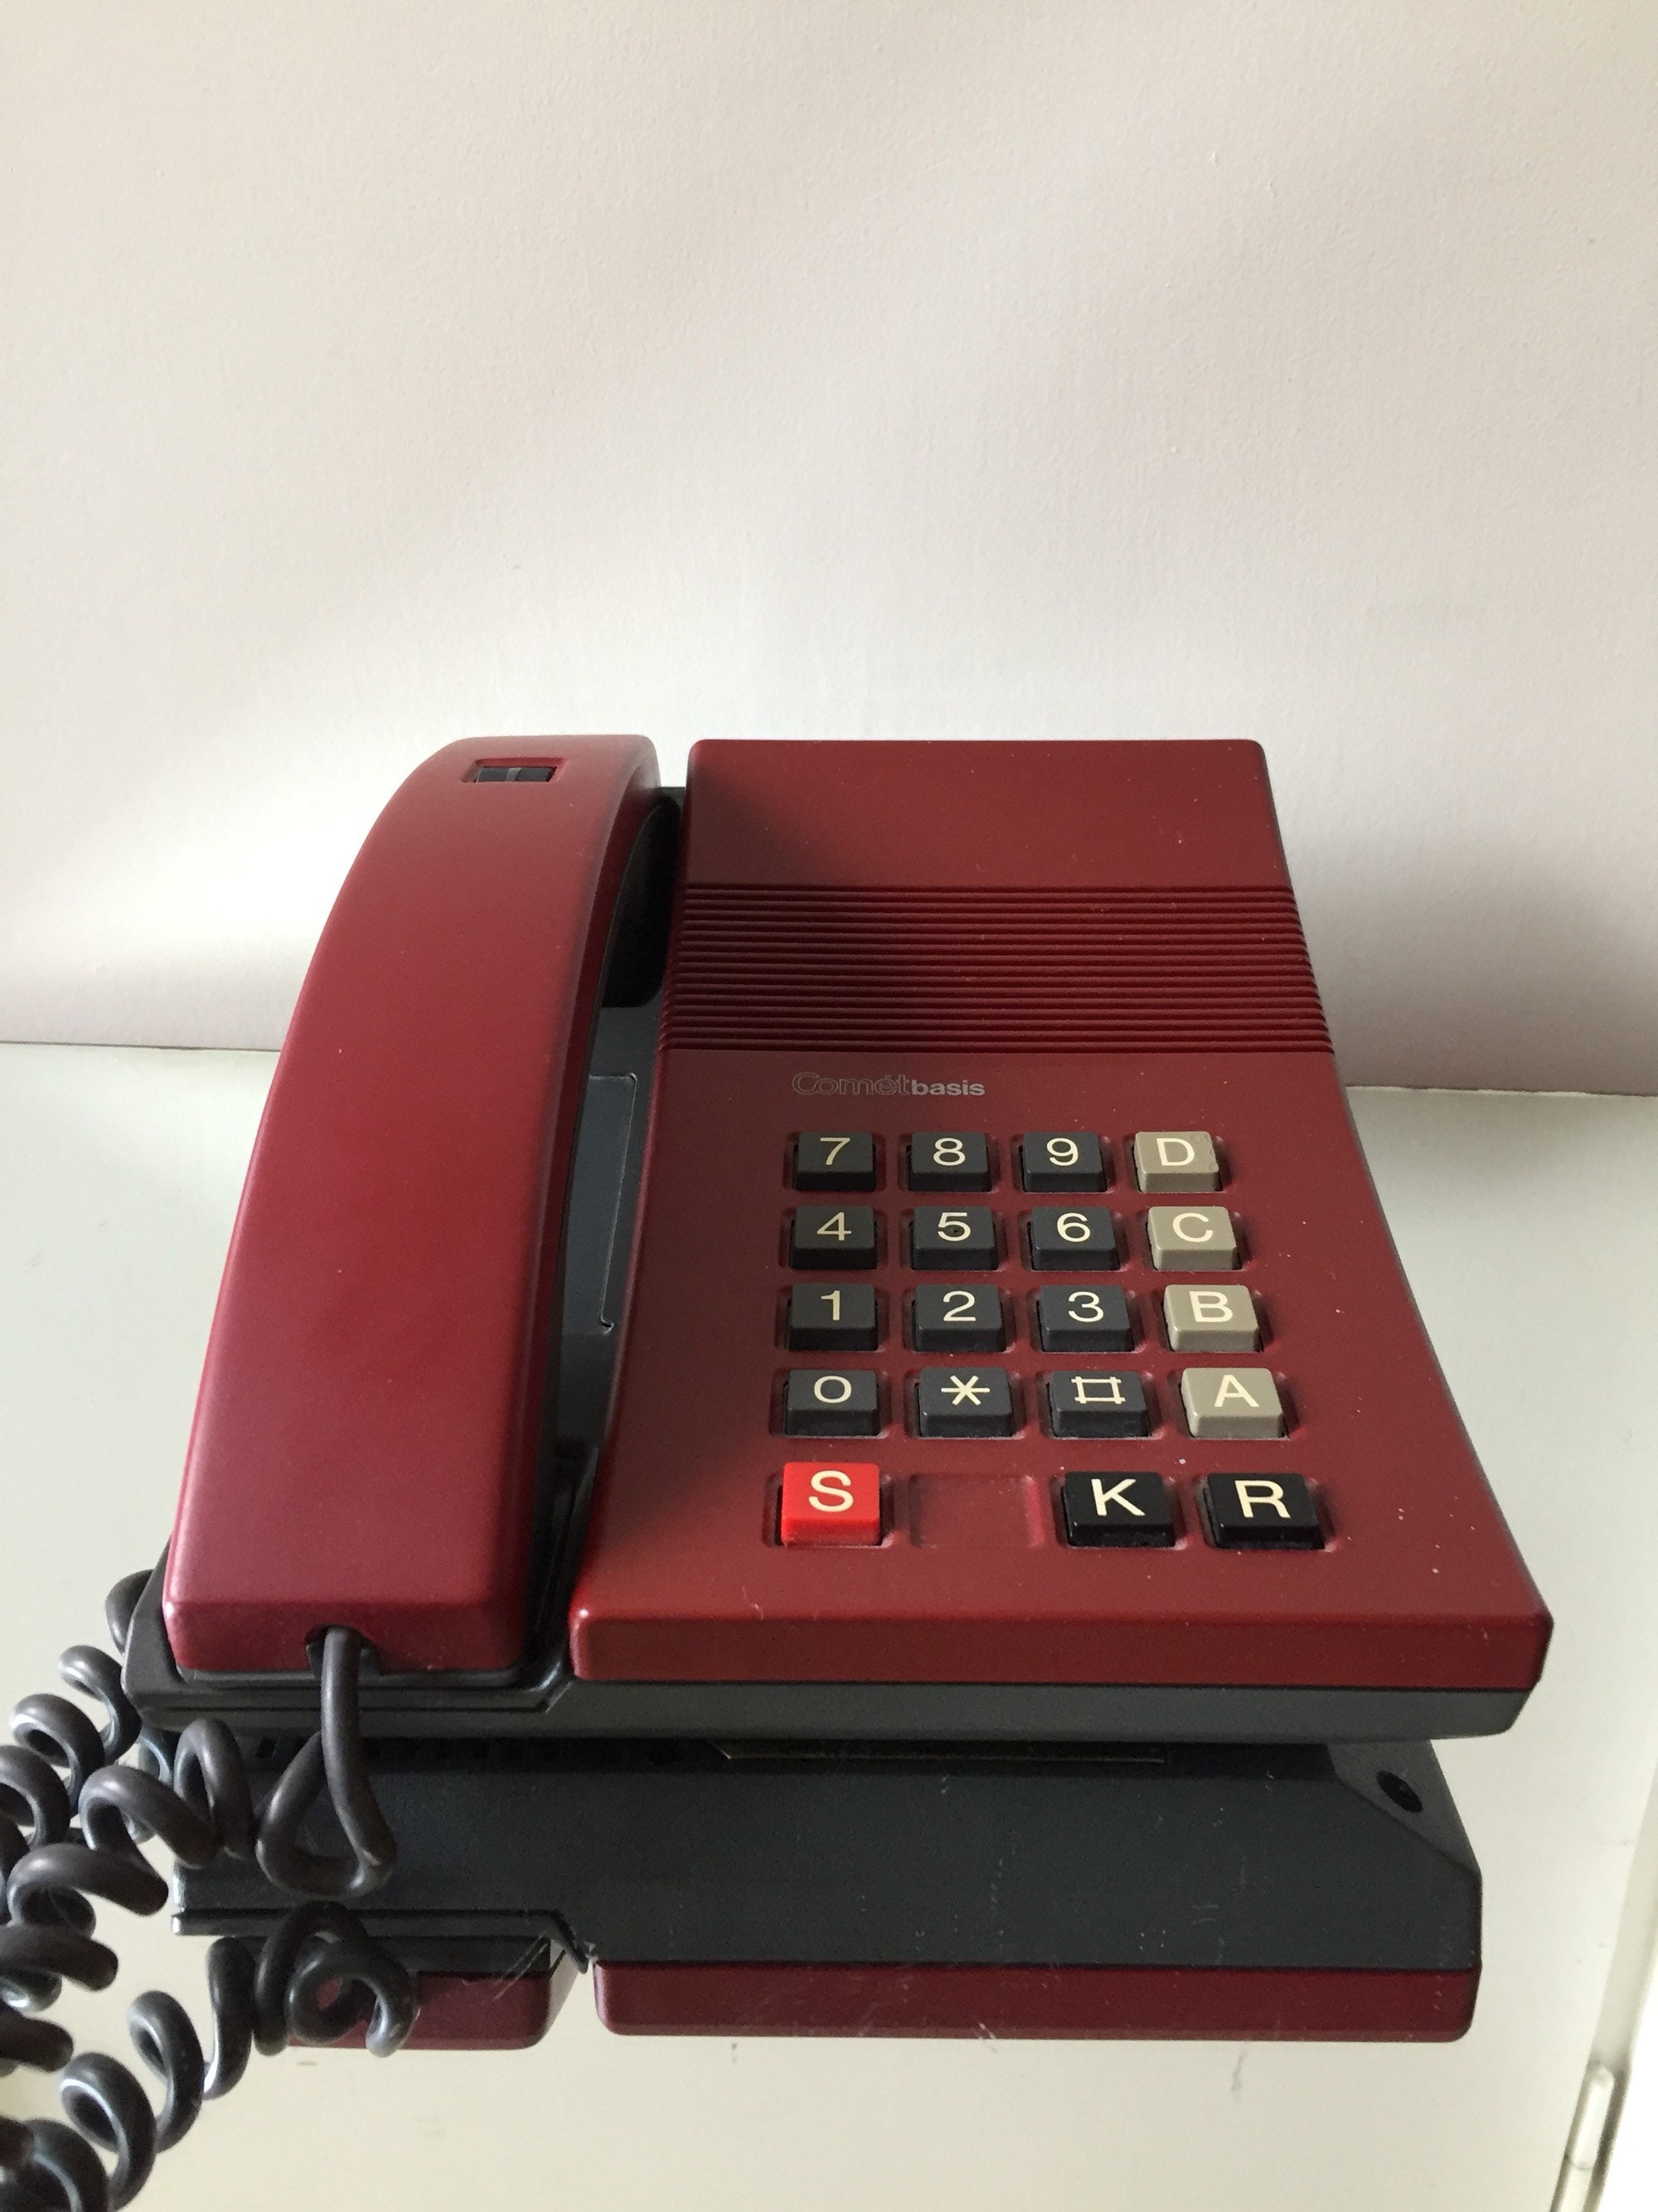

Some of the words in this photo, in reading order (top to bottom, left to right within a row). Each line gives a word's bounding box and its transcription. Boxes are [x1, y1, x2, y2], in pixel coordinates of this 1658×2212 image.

[820, 1137, 851, 1166] 7
[933, 1138, 966, 1167] 8
[1046, 1138, 1079, 1167] 9
[1156, 1138, 1195, 1167] D
[817, 1211, 852, 1241] 4
[937, 1211, 971, 1242] 5
[1057, 1212, 1091, 1243] 6
[1172, 1212, 1214, 1243] C
[821, 1290, 841, 1321] 1
[943, 1290, 977, 1322] 2
[1068, 1291, 1104, 1322] 3
[1189, 1290, 1234, 1323] B
[1214, 1374, 1260, 1408] A
[808, 1470, 854, 1512] S
[1091, 1478, 1146, 1516] K
[1234, 1480, 1291, 1519] R
